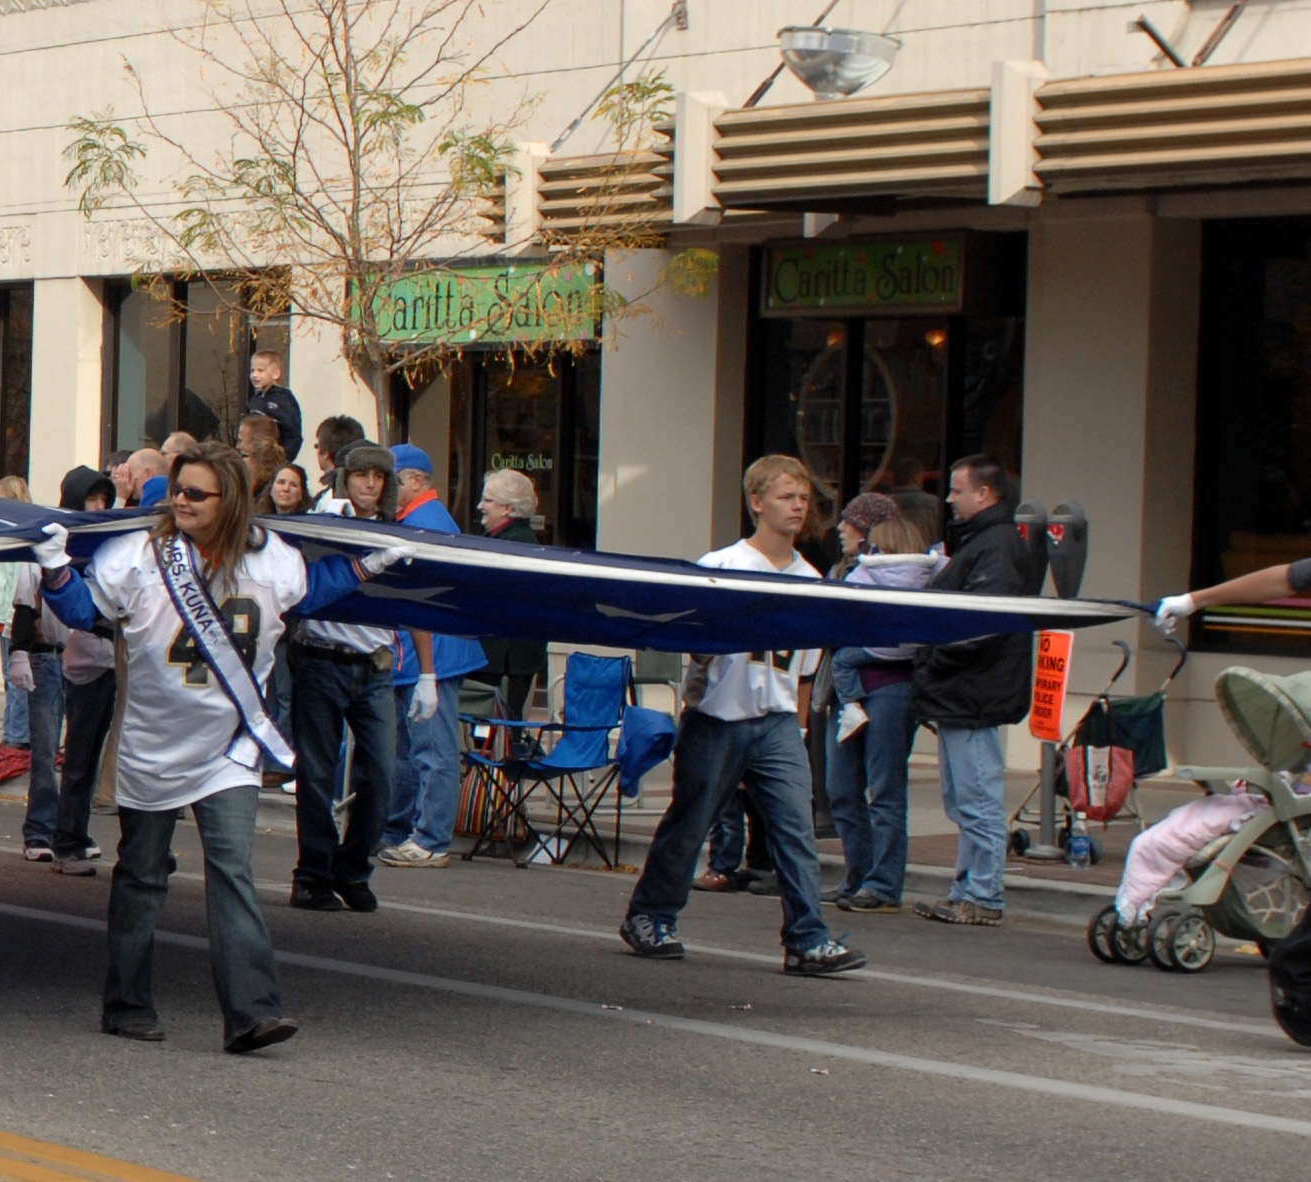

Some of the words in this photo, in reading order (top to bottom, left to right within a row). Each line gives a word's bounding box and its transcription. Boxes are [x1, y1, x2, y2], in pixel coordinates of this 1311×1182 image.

[775, 258, 866, 302] Caritta
[876, 253, 954, 299] Salon
[491, 453, 524, 470] Caritta
[526, 453, 553, 470] Salon
[179, 581, 214, 632] KUNA
[1038, 655, 1065, 672] KING
[1034, 692, 1054, 705] OLICE
